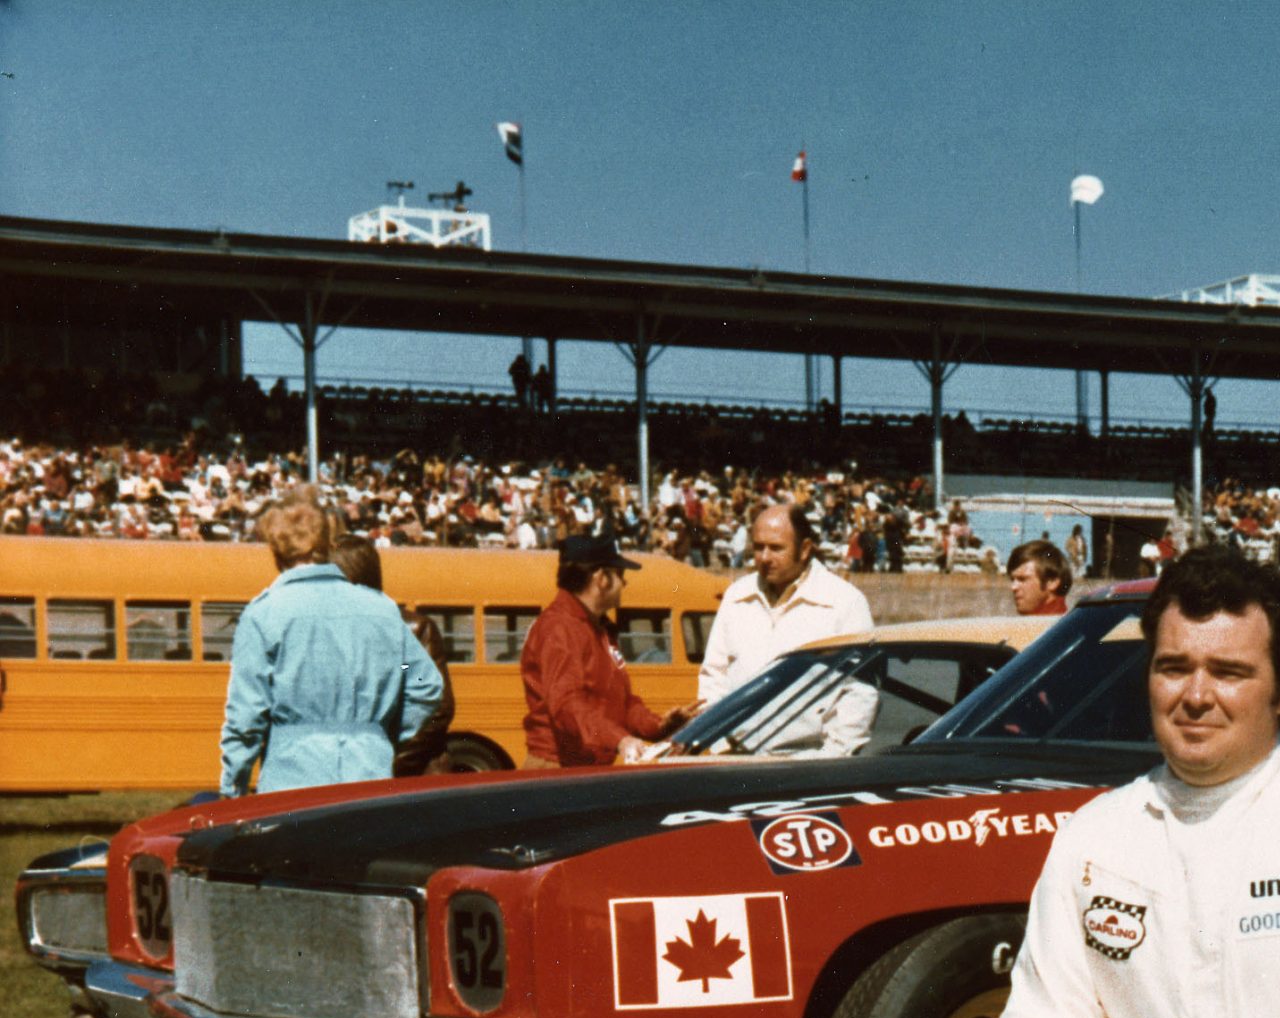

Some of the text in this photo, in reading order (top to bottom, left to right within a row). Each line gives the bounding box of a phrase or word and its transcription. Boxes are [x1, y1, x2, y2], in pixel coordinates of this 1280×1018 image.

[660, 792, 893, 826] 427
[773, 820, 836, 858] STP
[135, 869, 170, 941] 52
[1088, 919, 1137, 940] CARLING
[454, 911, 503, 989] 52
